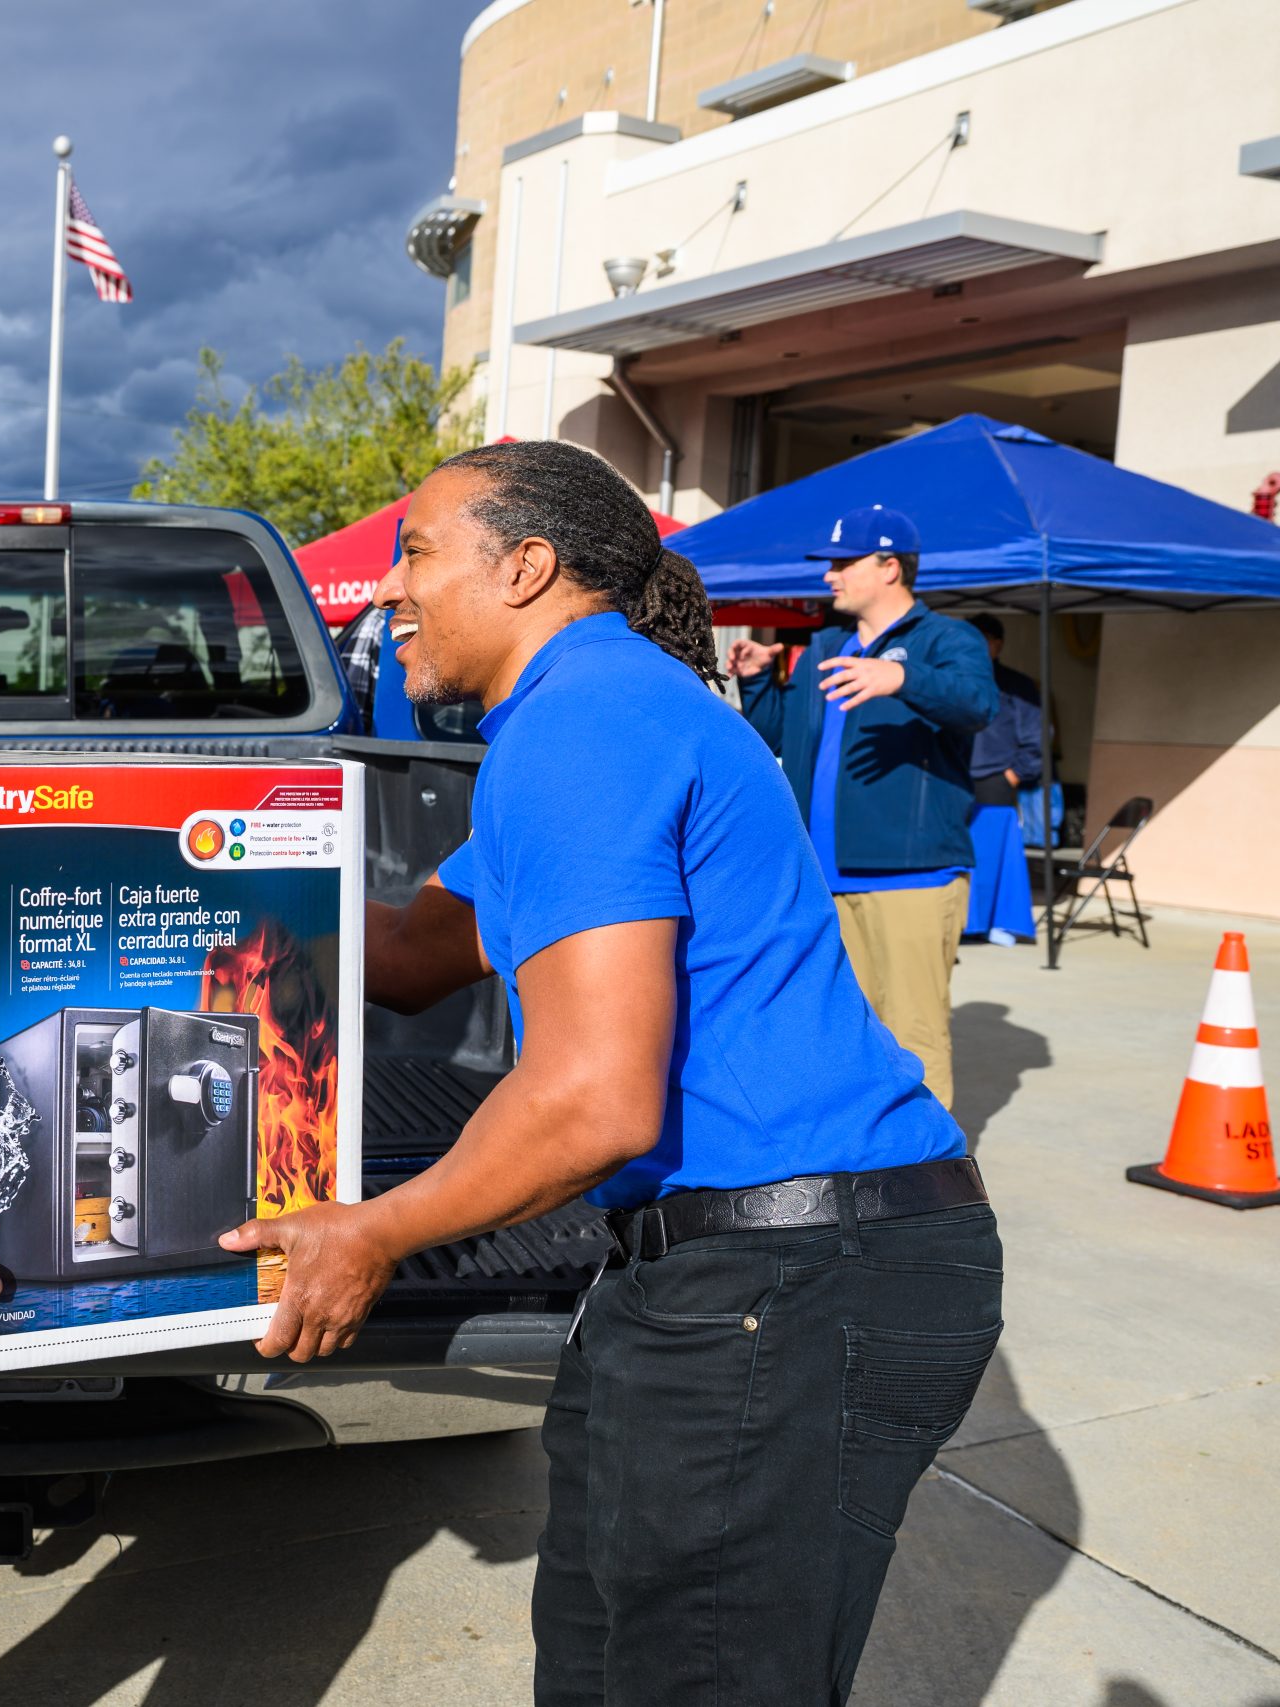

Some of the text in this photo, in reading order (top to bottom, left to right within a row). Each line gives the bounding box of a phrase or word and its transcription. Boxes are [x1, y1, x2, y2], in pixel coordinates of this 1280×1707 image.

[20, 886, 102, 907] Coffre-fort
[119, 884, 199, 909] Caja fuerte
[20, 909, 104, 933] numérique
[119, 905, 240, 931] extra grande con
[19, 932, 96, 954] format XL
[118, 927, 237, 952] cerradura digital
[82, 960, 86, 968] L
[129, 956, 186, 966] CAPACIDAD: 34.8 L
[43, 974, 80, 982] rétro-éclairé
[173, 969, 215, 977] retroiluminado
[29, 985, 51, 993] plateau
[51, 983, 76, 992] réglable
[124, 980, 146, 988] bandeja
[147, 979, 173, 988] ajustable
